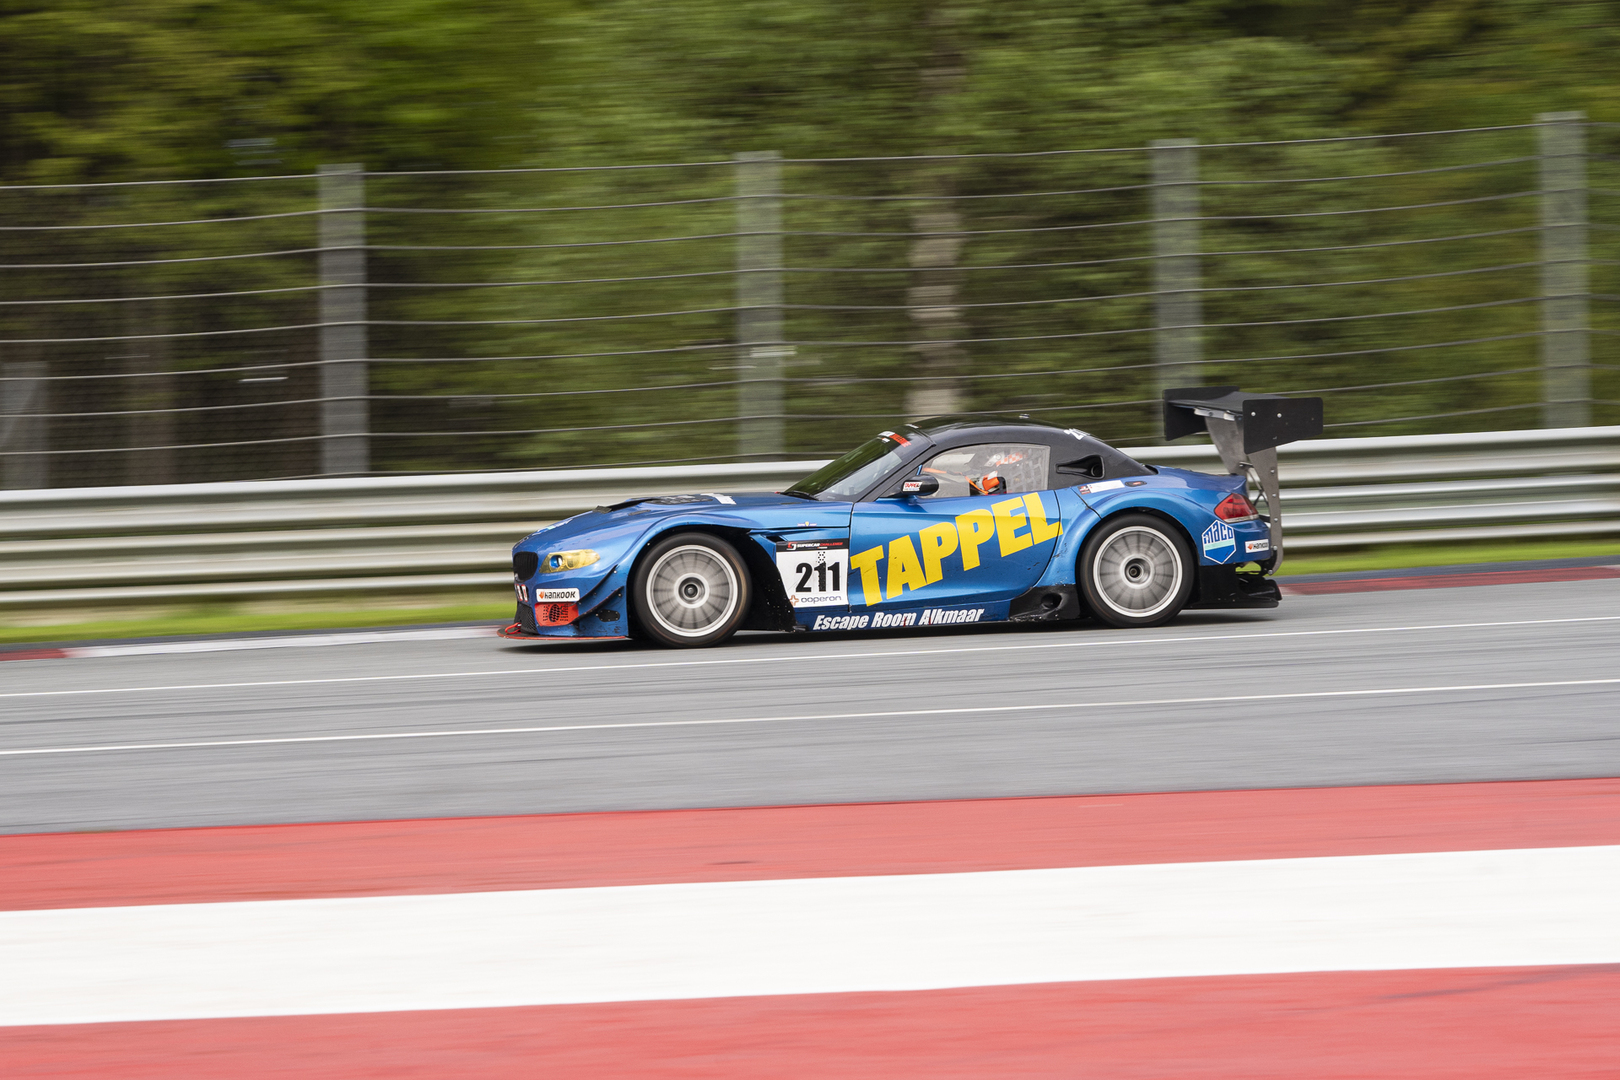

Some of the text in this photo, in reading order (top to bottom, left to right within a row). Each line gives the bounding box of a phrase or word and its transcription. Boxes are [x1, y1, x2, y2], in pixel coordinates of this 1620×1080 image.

[850, 492, 1063, 607] TAPPEL
[795, 561, 841, 592] 211
[813, 608, 985, 631] Escape Room Alkmaar
